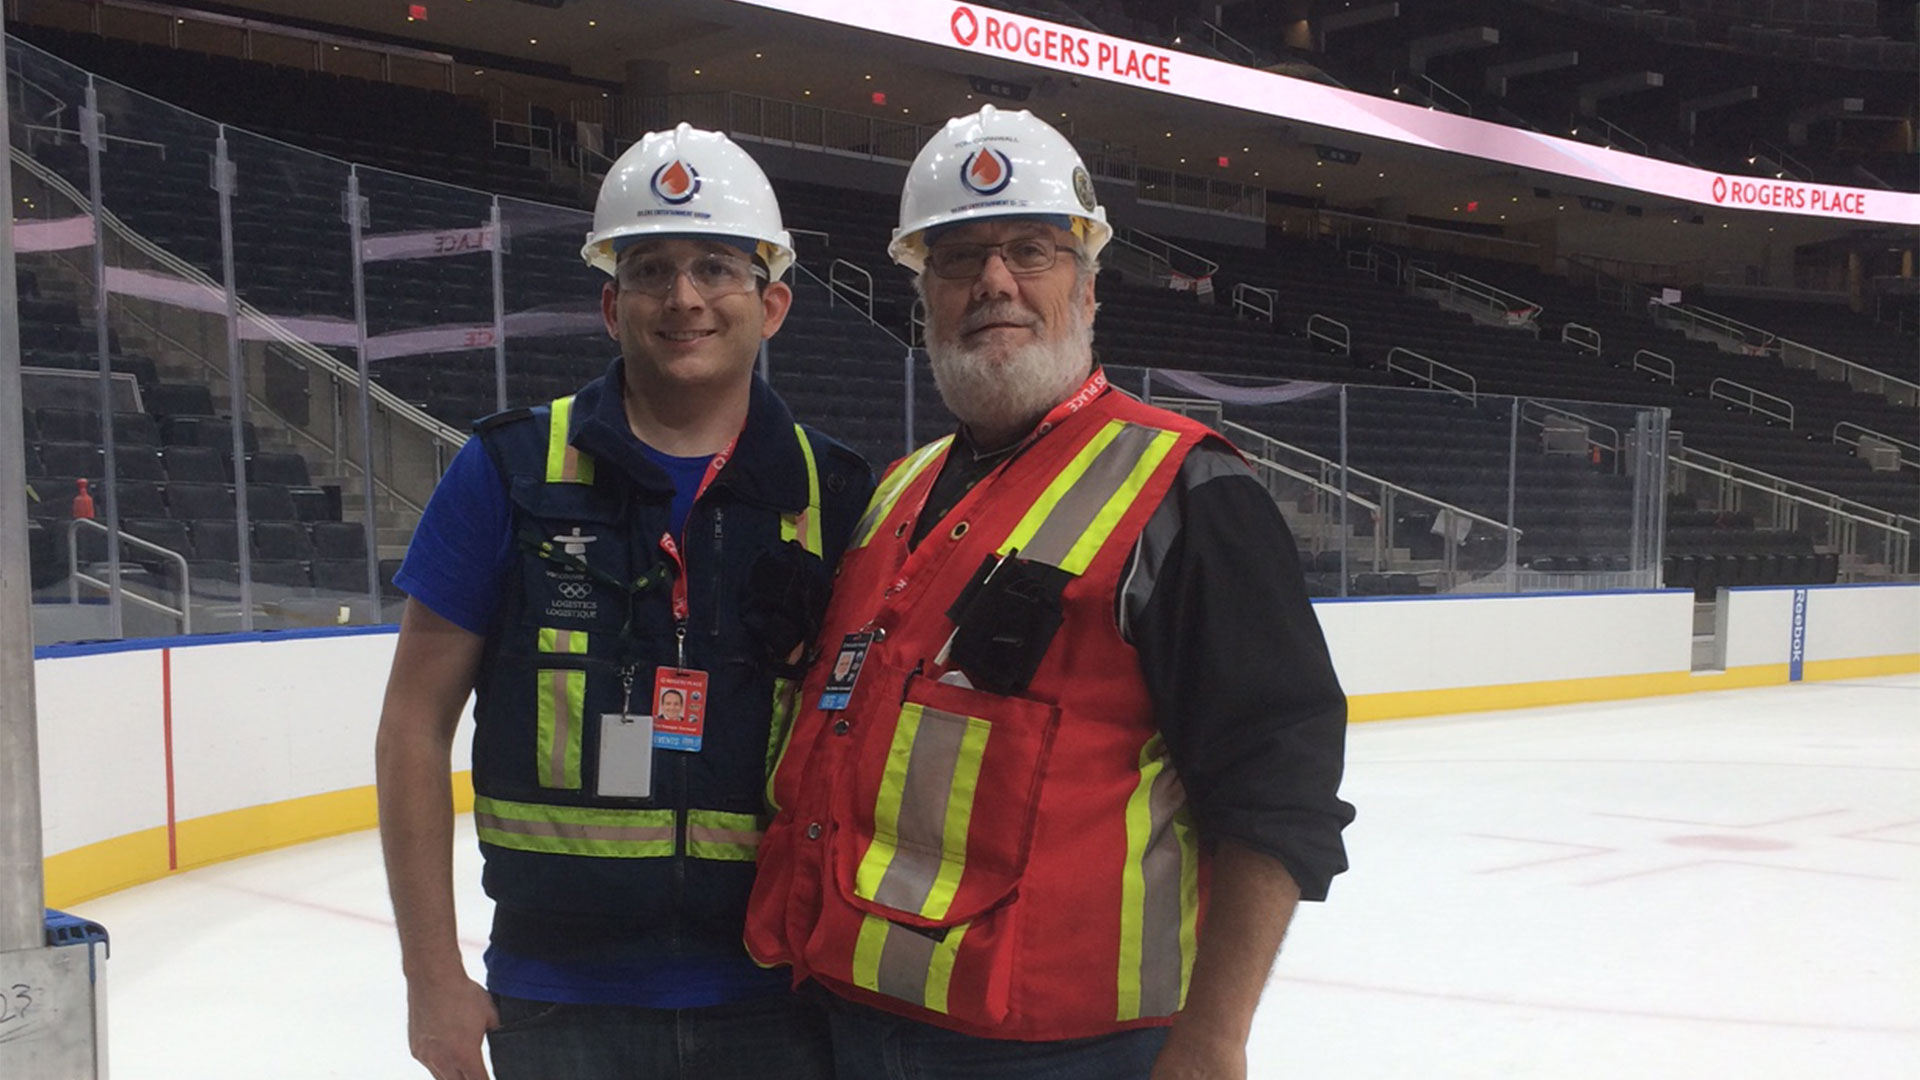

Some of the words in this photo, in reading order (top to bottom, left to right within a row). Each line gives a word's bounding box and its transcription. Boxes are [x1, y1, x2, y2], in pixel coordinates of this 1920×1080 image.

[985, 16, 1090, 67] ROGERS
[1098, 42, 1171, 86] PLACE
[1731, 181, 1806, 209] ROGERS
[1811, 189, 1866, 215] PLACE
[1065, 383, 1099, 413] PLACE
[545, 608, 597, 619] LOGISTIQUE
[551, 600, 598, 609] LOGISTICS
[1792, 590, 1805, 662] Reebok
